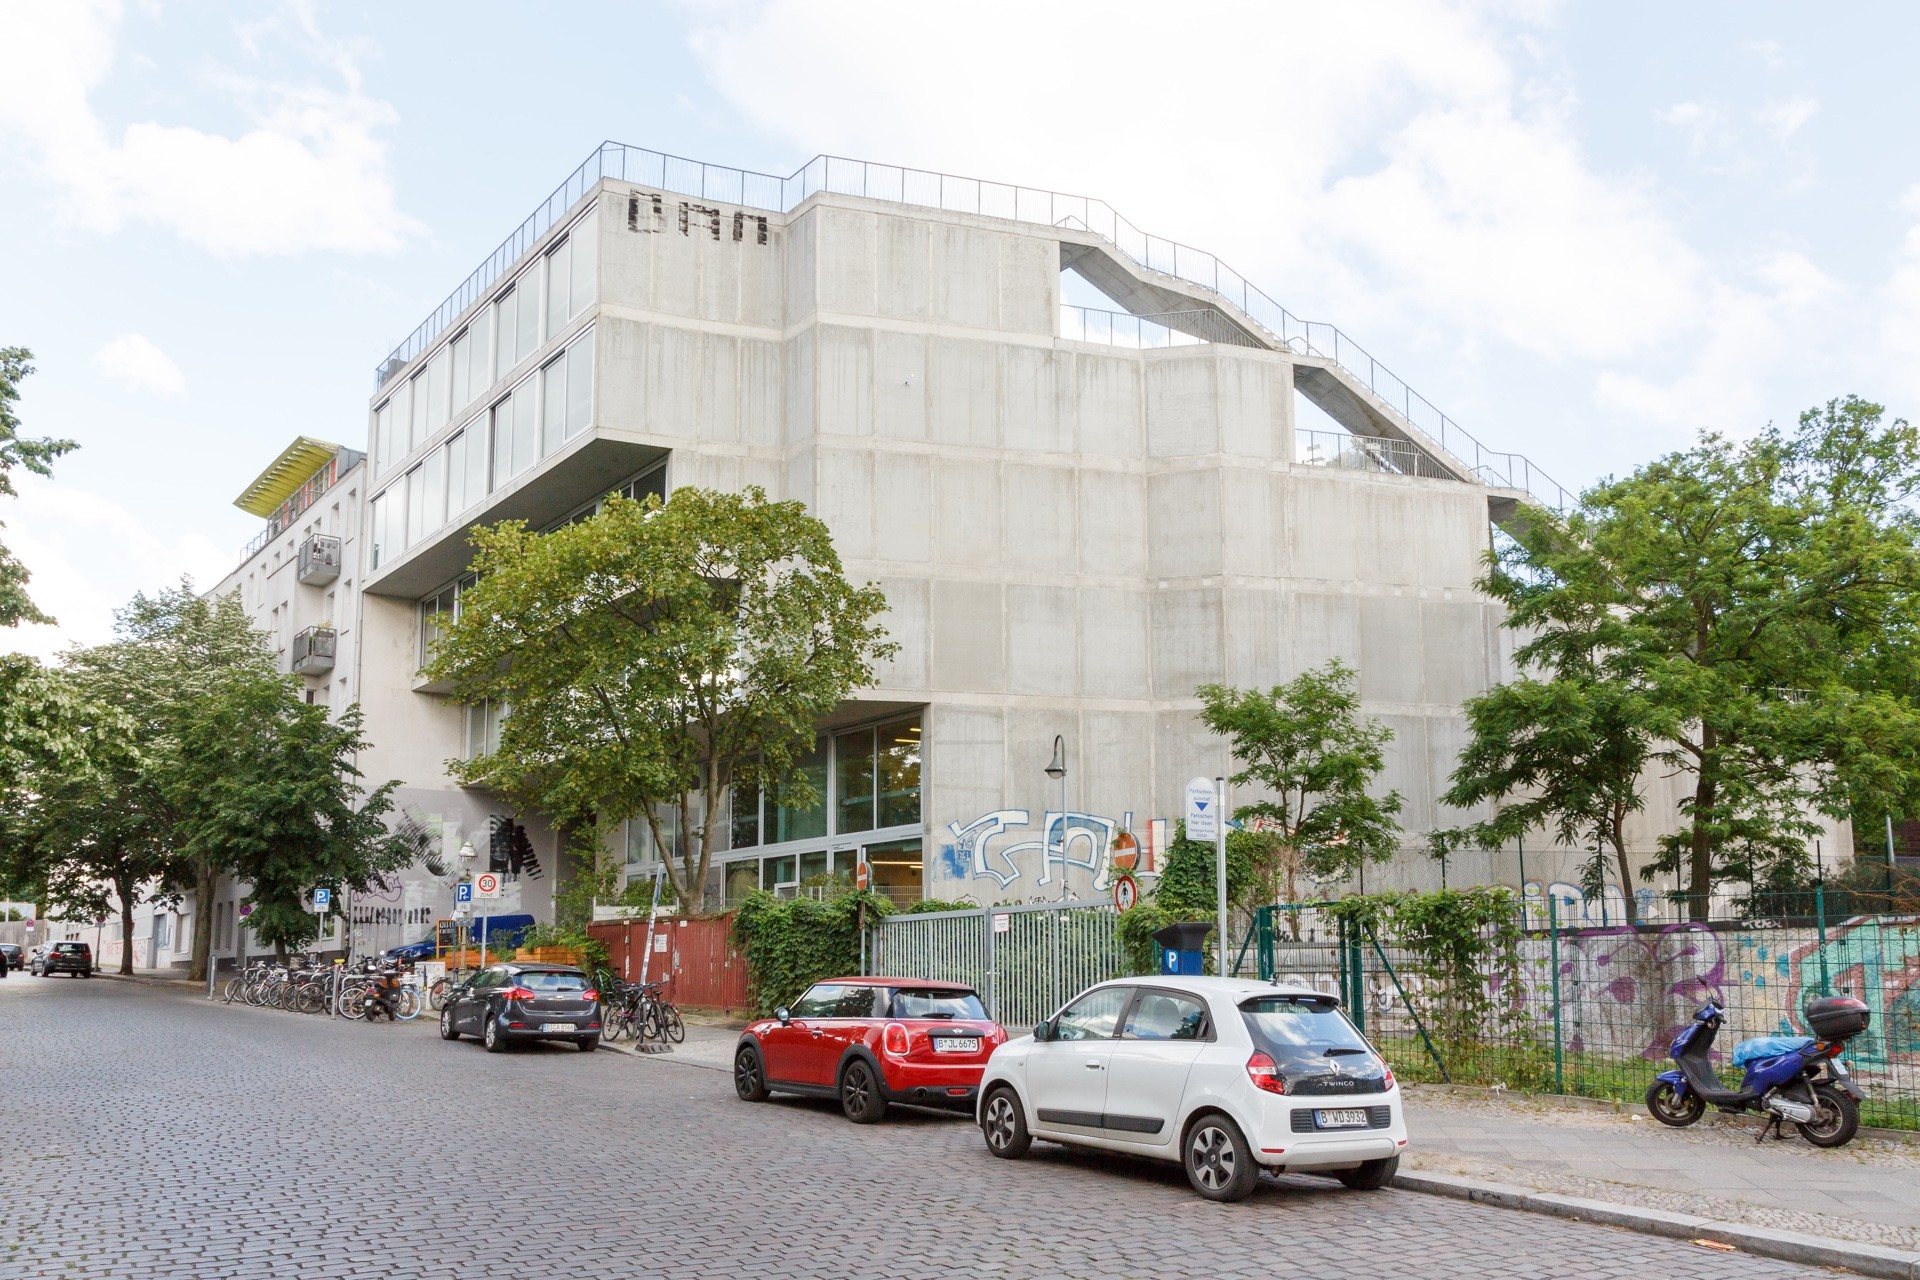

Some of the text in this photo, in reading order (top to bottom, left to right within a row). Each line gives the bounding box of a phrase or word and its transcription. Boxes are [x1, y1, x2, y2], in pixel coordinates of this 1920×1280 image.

[482, 879, 493, 888] 30
[317, 891, 326, 902] P
[459, 886, 468, 900] P
[1168, 951, 1177, 968] P
[938, 1039, 944, 1048] B
[958, 1039, 977, 1049] 6675
[1321, 1110, 1367, 1124] B WD 3932
